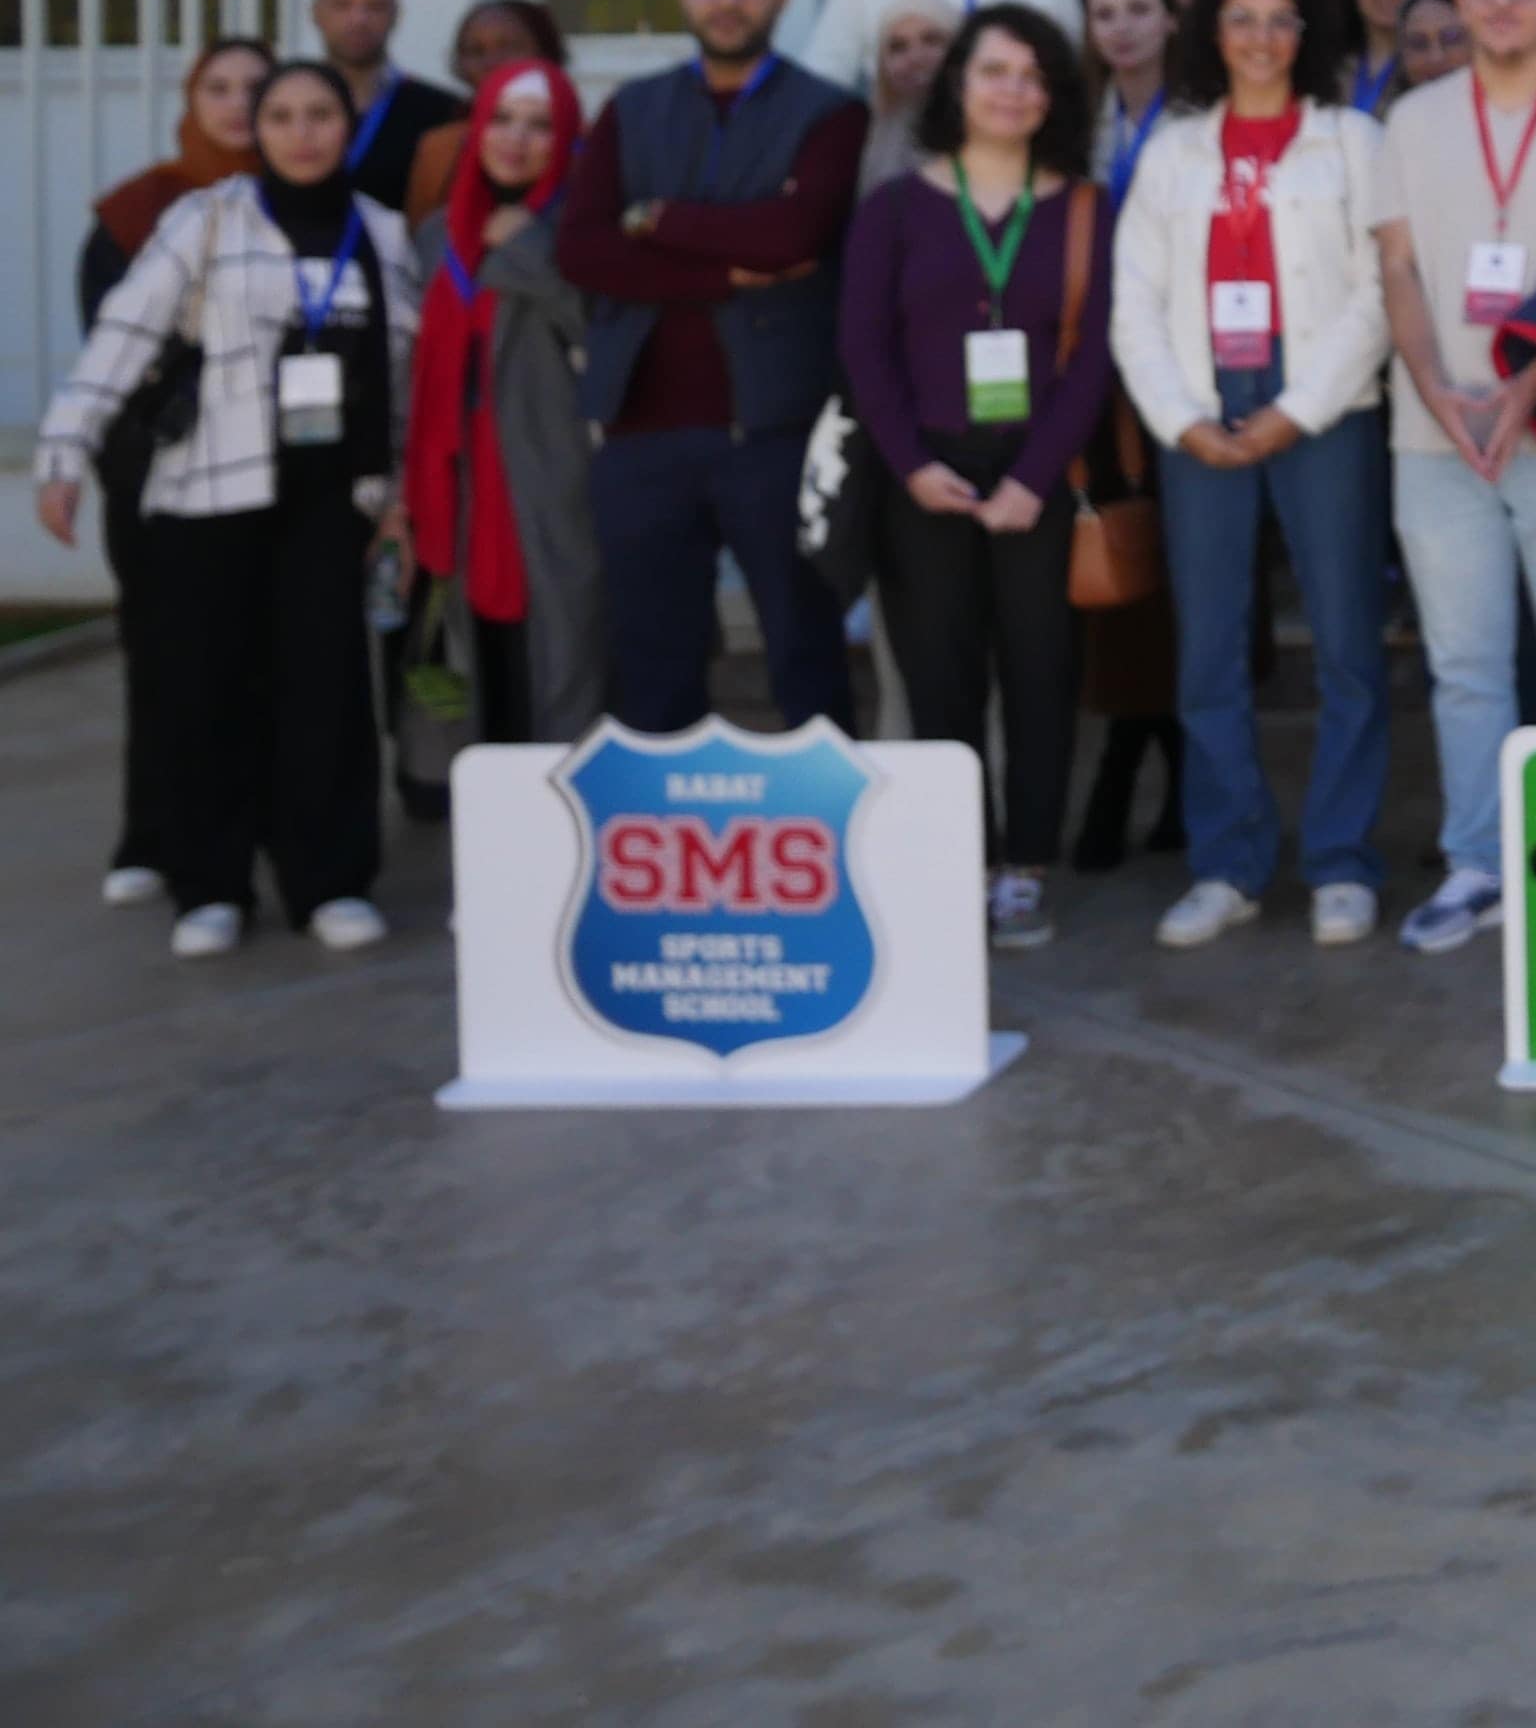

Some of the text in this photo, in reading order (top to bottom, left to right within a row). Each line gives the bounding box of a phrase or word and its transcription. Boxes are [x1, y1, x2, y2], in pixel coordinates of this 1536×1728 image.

[665, 773, 767, 803] RABAT
[602, 819, 835, 910] SMS
[660, 933, 783, 962] SPORTS
[611, 962, 832, 993] MANAGEMENT
[662, 994, 781, 1022] SCHOOL
